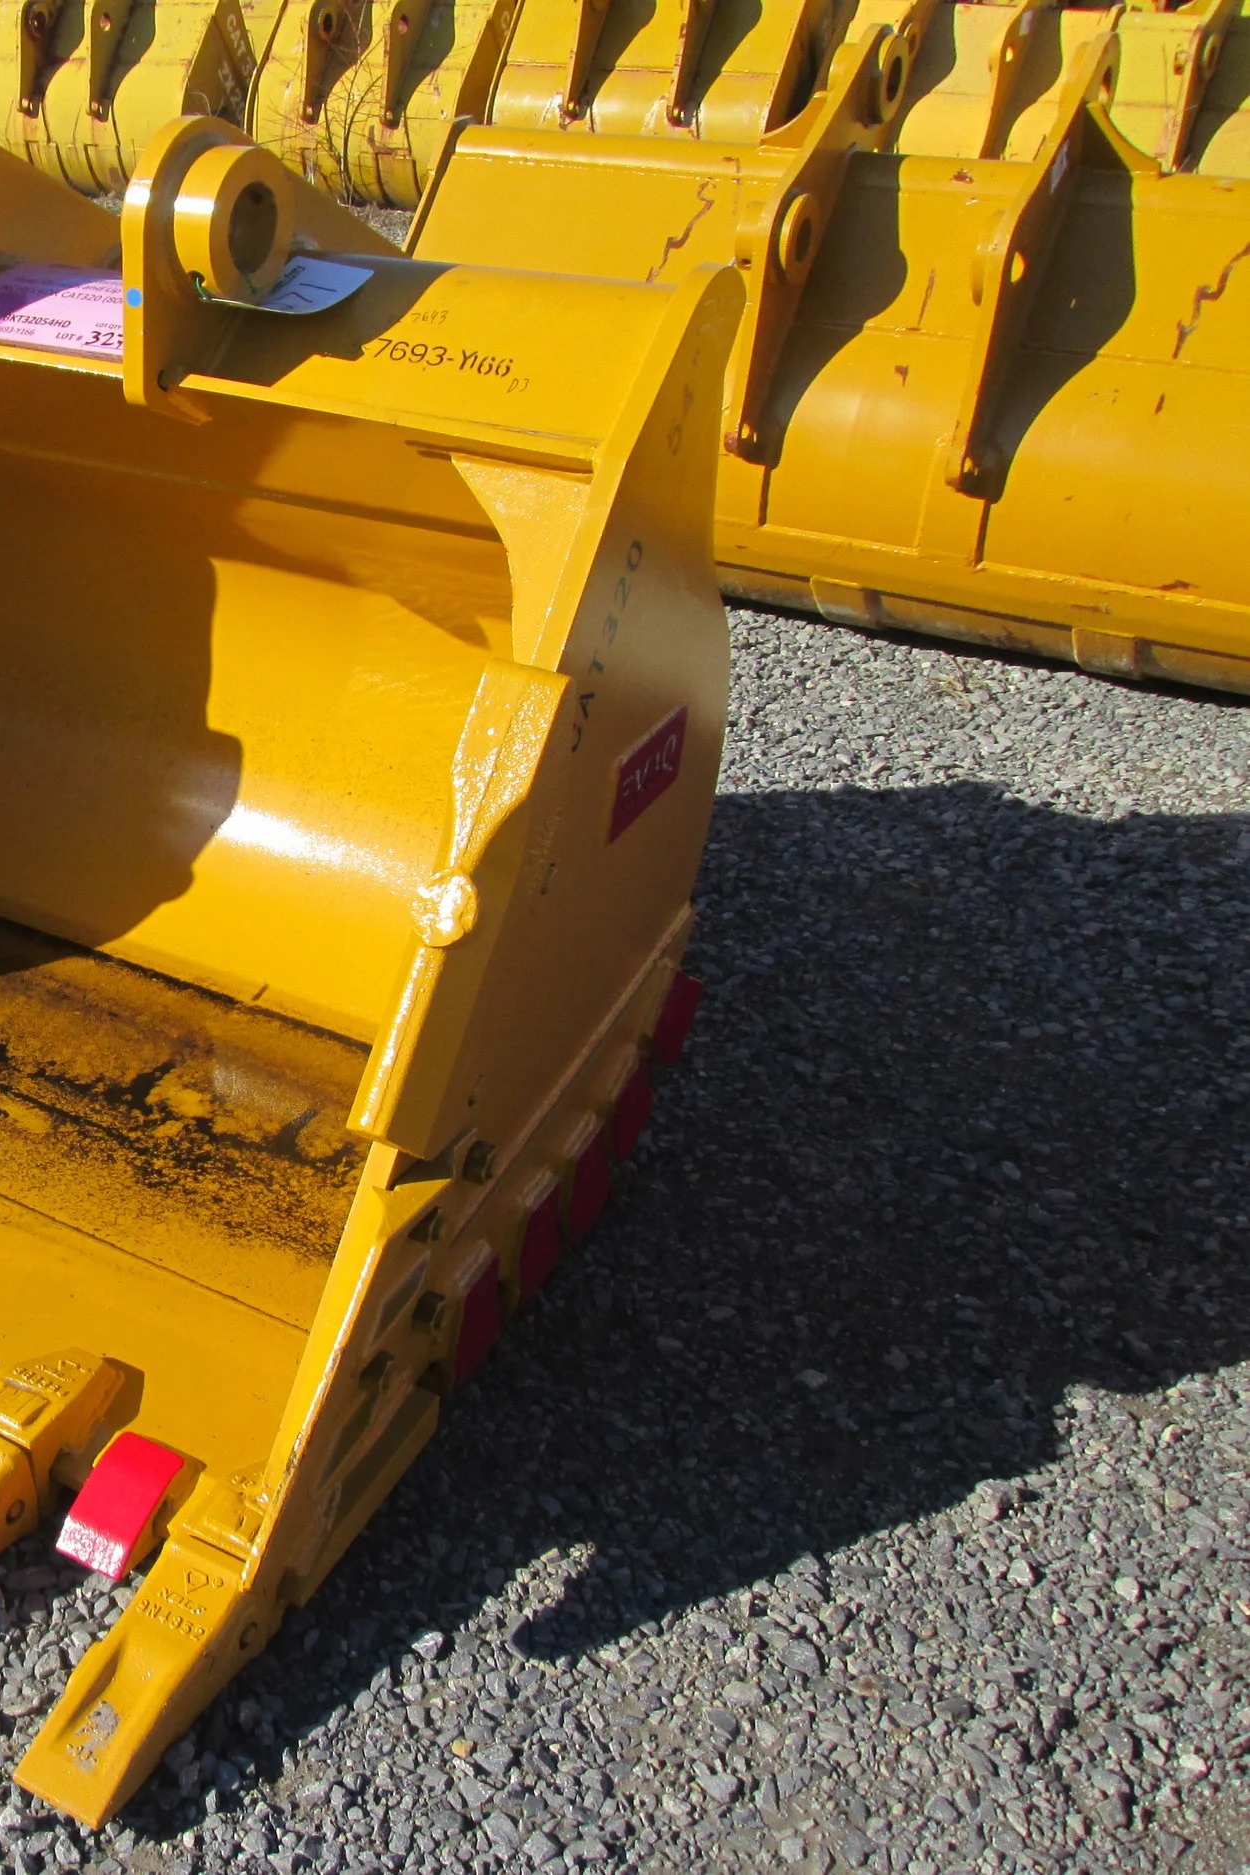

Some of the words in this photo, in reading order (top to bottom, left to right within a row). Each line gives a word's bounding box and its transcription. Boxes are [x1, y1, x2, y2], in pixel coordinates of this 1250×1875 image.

[61, 291, 103, 302] CAT320
[54, 331, 75, 342] LOT
[373, 337, 515, 377] 7693-Y166
